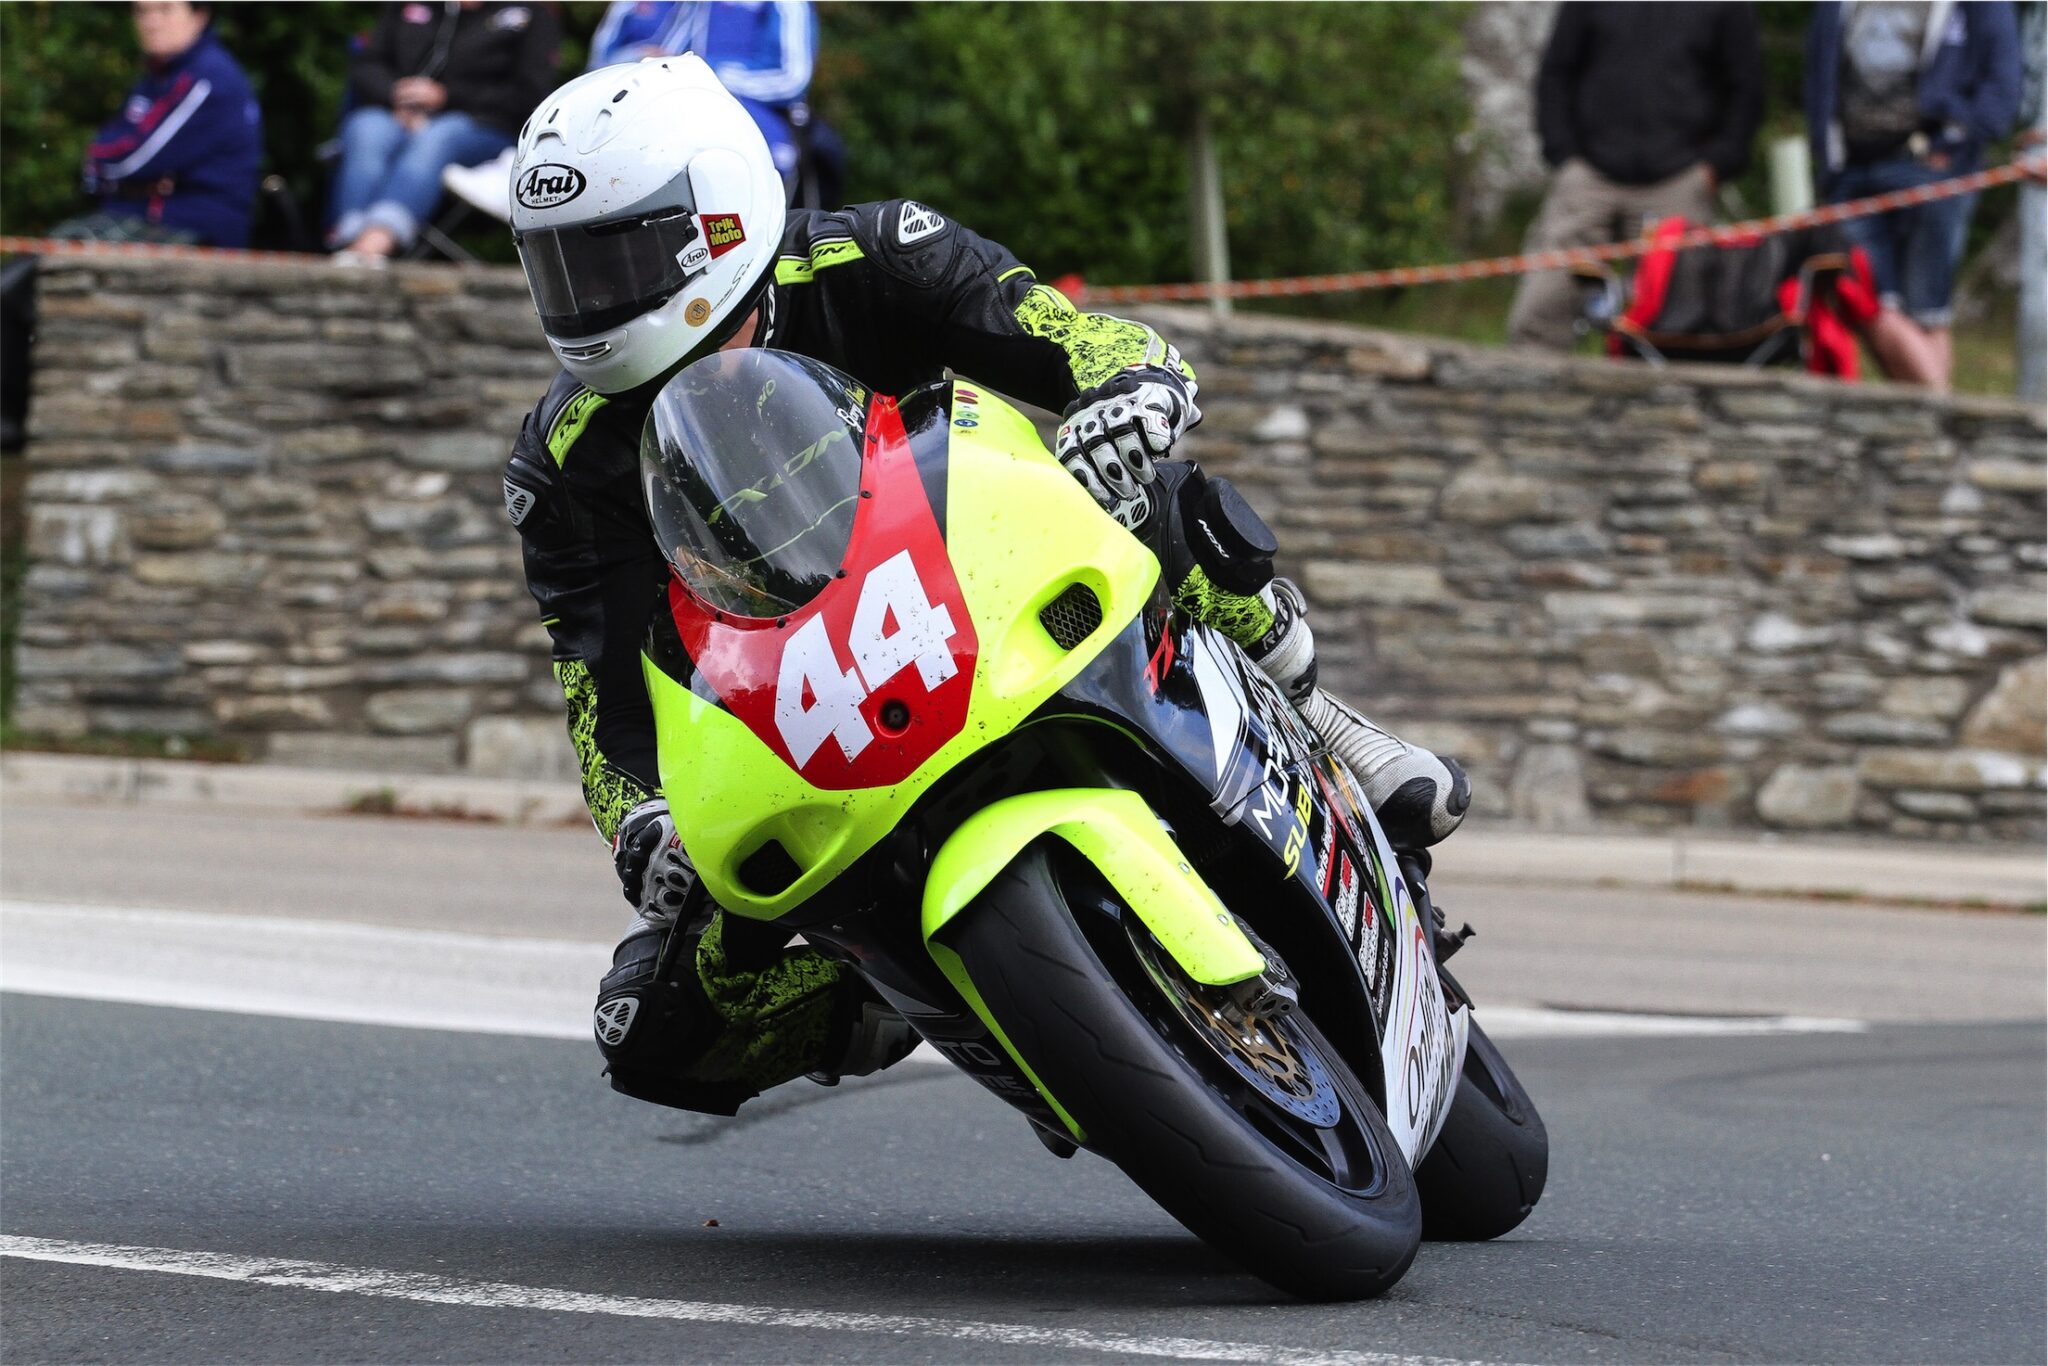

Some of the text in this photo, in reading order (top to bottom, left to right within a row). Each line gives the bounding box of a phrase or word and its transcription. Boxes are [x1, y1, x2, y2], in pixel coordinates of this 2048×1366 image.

[519, 168, 576, 198] Arai
[708, 217, 736, 234] Trik
[710, 228, 743, 247] Moto
[685, 249, 706, 266] Arai
[559, 389, 597, 440] IXO
[773, 547, 960, 771] 44
